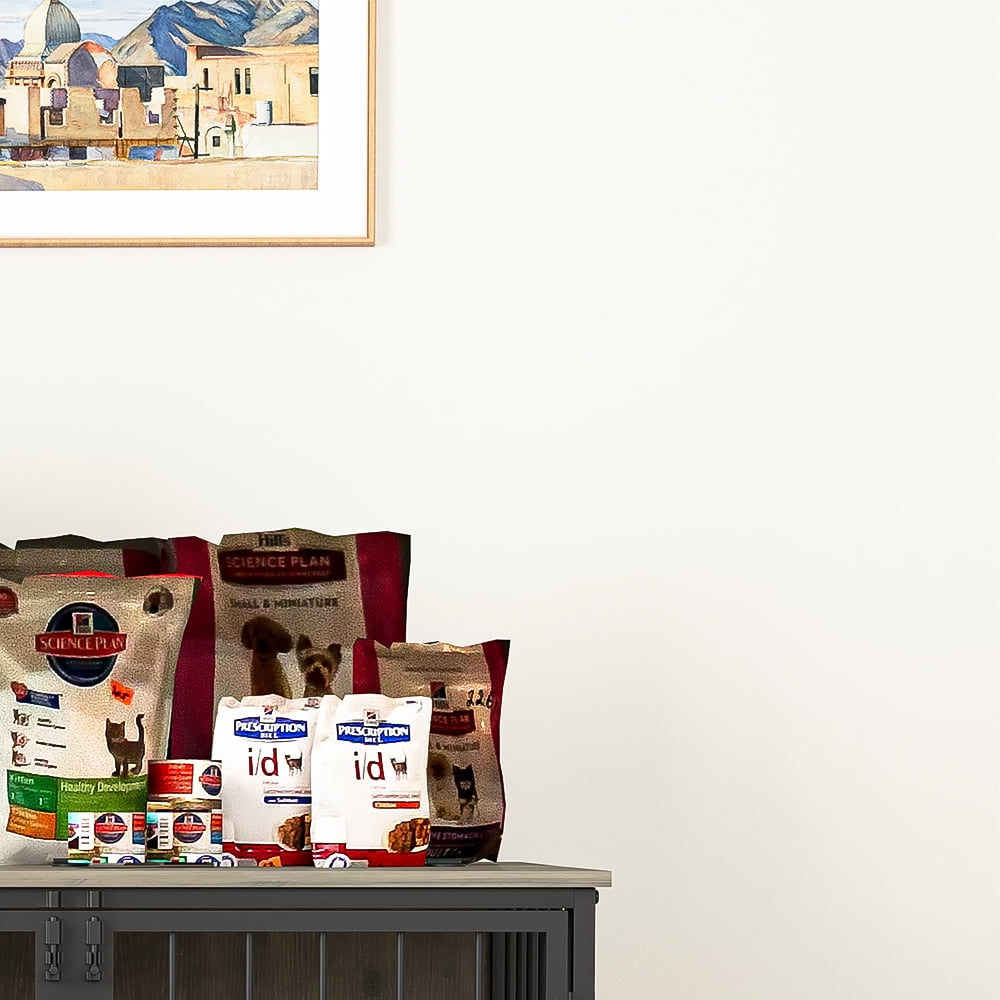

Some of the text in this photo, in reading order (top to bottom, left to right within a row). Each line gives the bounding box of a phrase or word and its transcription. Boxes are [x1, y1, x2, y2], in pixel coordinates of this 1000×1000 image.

[225, 554, 331, 569] SCIENCE PLAN
[40, 636, 126, 651] SCIENCE PLAN
[235, 719, 306, 733] PRESCRIPTION
[338, 725, 409, 738] PRESCRIPTION
[247, 747, 279, 777] i/d
[353, 751, 386, 781] i/d
[8, 773, 35, 785] Kitten
[60, 780, 96, 796] Healthy
